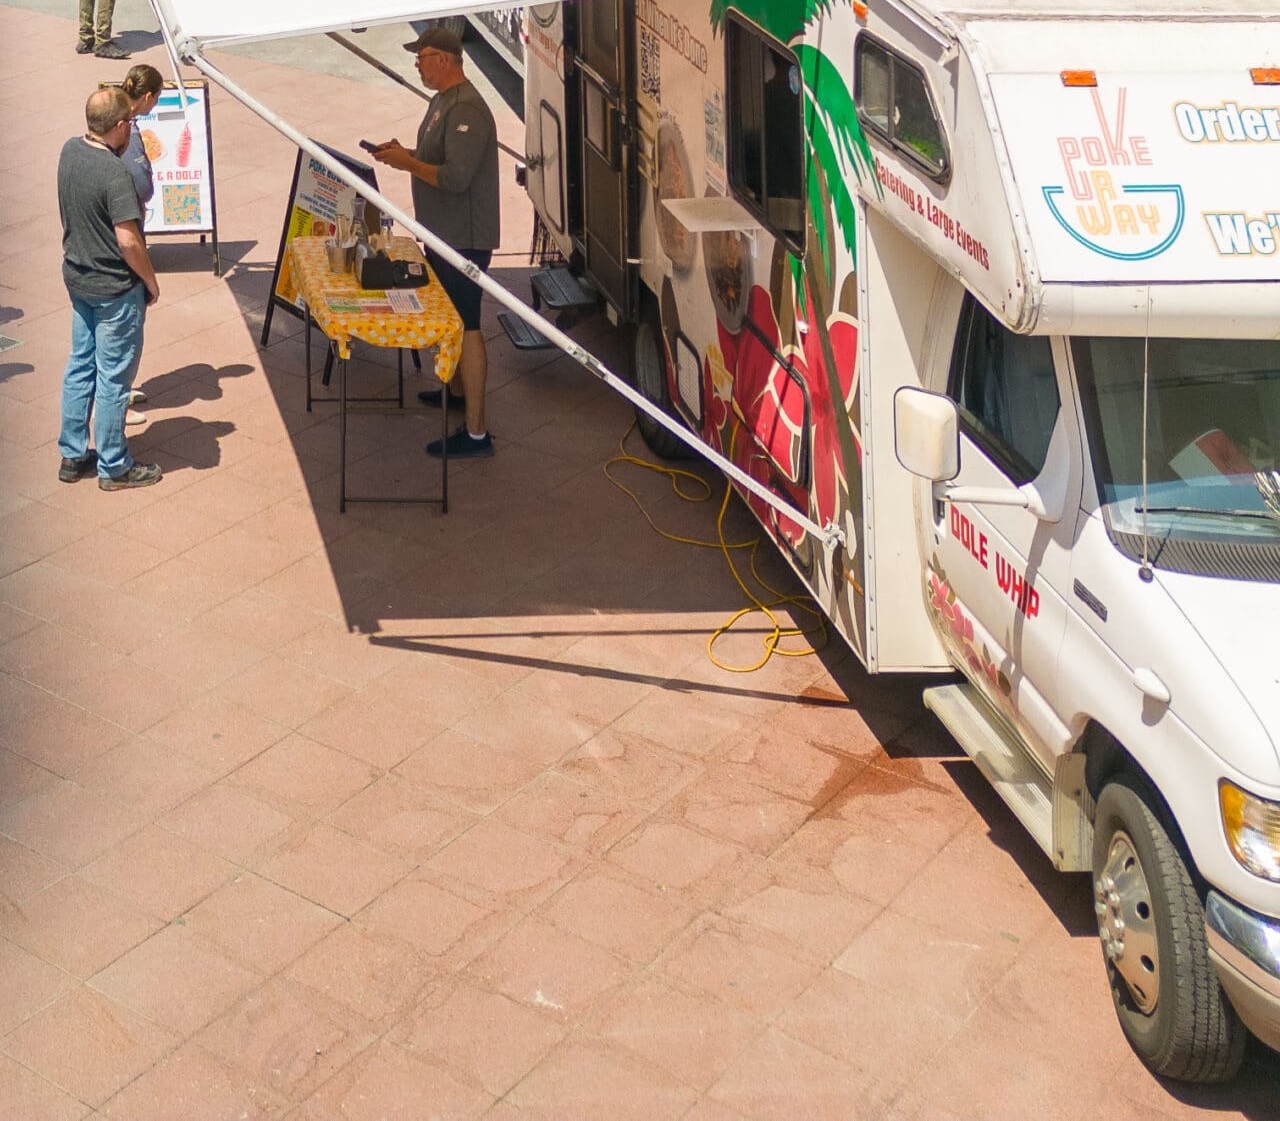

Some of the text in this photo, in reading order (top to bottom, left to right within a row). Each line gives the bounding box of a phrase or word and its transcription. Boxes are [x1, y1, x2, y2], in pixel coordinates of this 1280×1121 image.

[683, 24, 708, 75] Done
[1174, 101, 1280, 143] Order
[875, 156, 990, 271] Catering & Large Events
[1076, 204, 1161, 236] WAY
[950, 504, 988, 570] DOLE
[995, 550, 1040, 620] WHIP
